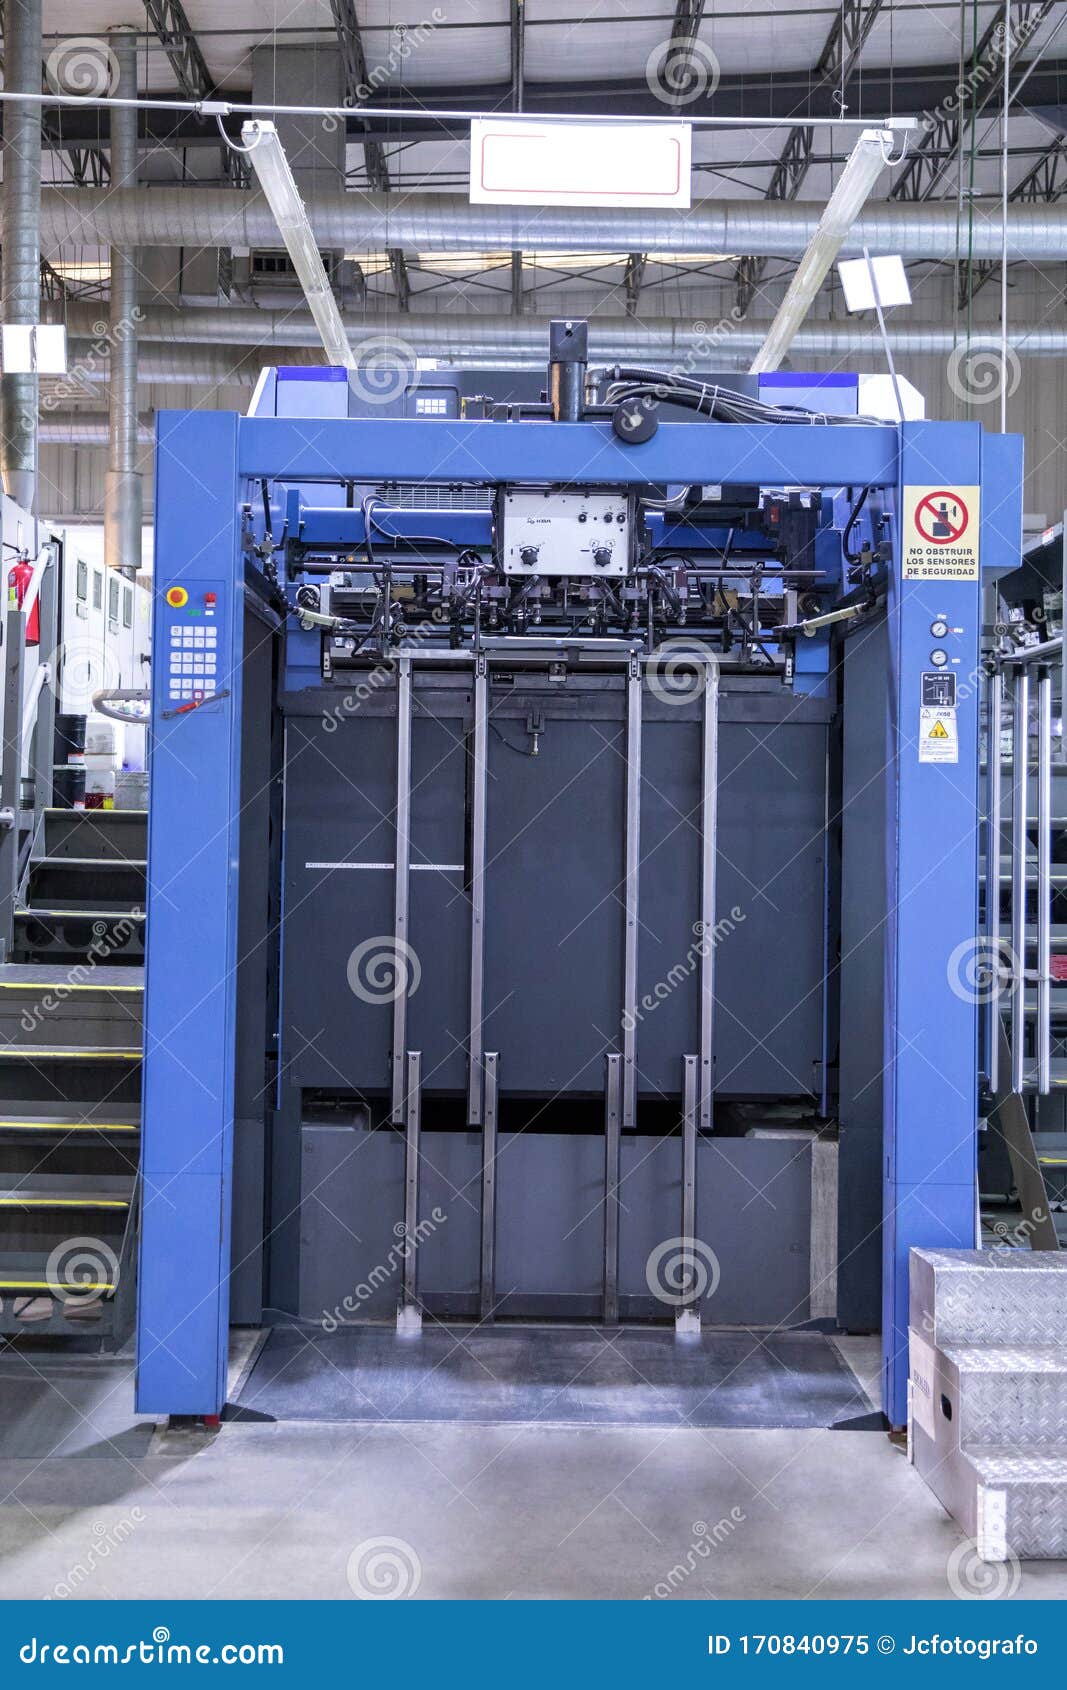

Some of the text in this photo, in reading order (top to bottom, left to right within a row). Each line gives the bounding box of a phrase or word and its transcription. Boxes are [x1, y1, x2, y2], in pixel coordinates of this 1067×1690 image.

[926, 548, 973, 556] OBSTRUIR
[927, 558, 976, 566] SENSORES
[922, 568, 975, 576] SEGURIDAD
